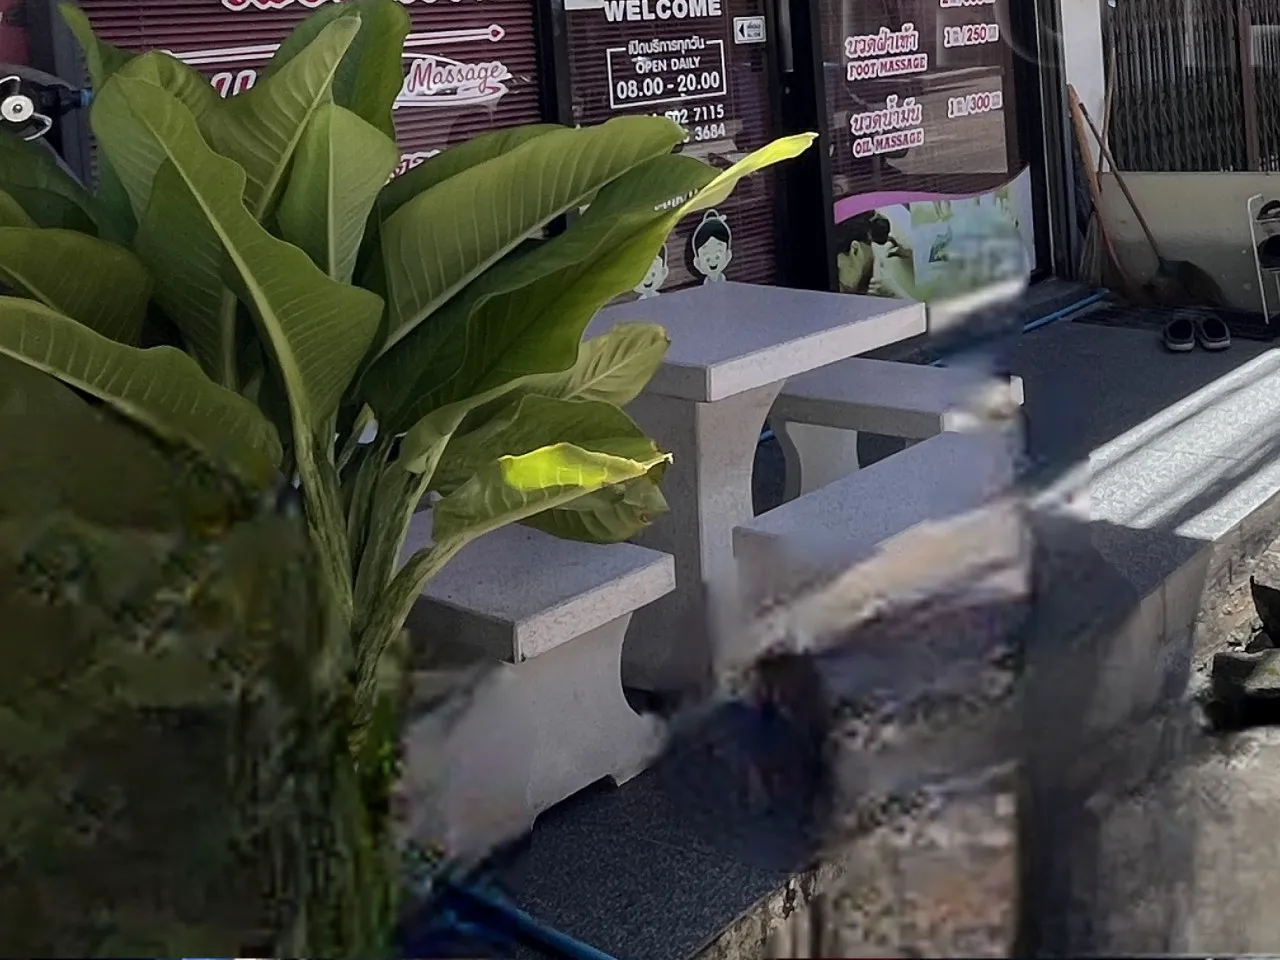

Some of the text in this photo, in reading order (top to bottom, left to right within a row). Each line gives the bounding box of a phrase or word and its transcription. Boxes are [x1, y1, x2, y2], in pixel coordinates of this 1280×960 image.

[628, 35, 705, 55] เปิดบริการทุกวัน
[845, 23, 919, 58] นวดฝ่าเท้า
[404, 58, 510, 96] Massage
[635, 56, 701, 74] OPEN DAILY
[847, 53, 928, 81] FOOT MASSAGE
[616, 76, 664, 100] 08.00
[677, 71, 720, 93] 20.00
[693, 103, 725, 122] 7115
[850, 94, 922, 136] นวดน้ำมัน
[694, 123, 726, 141] 3684
[853, 128, 924, 158] OIL MASSAGE
